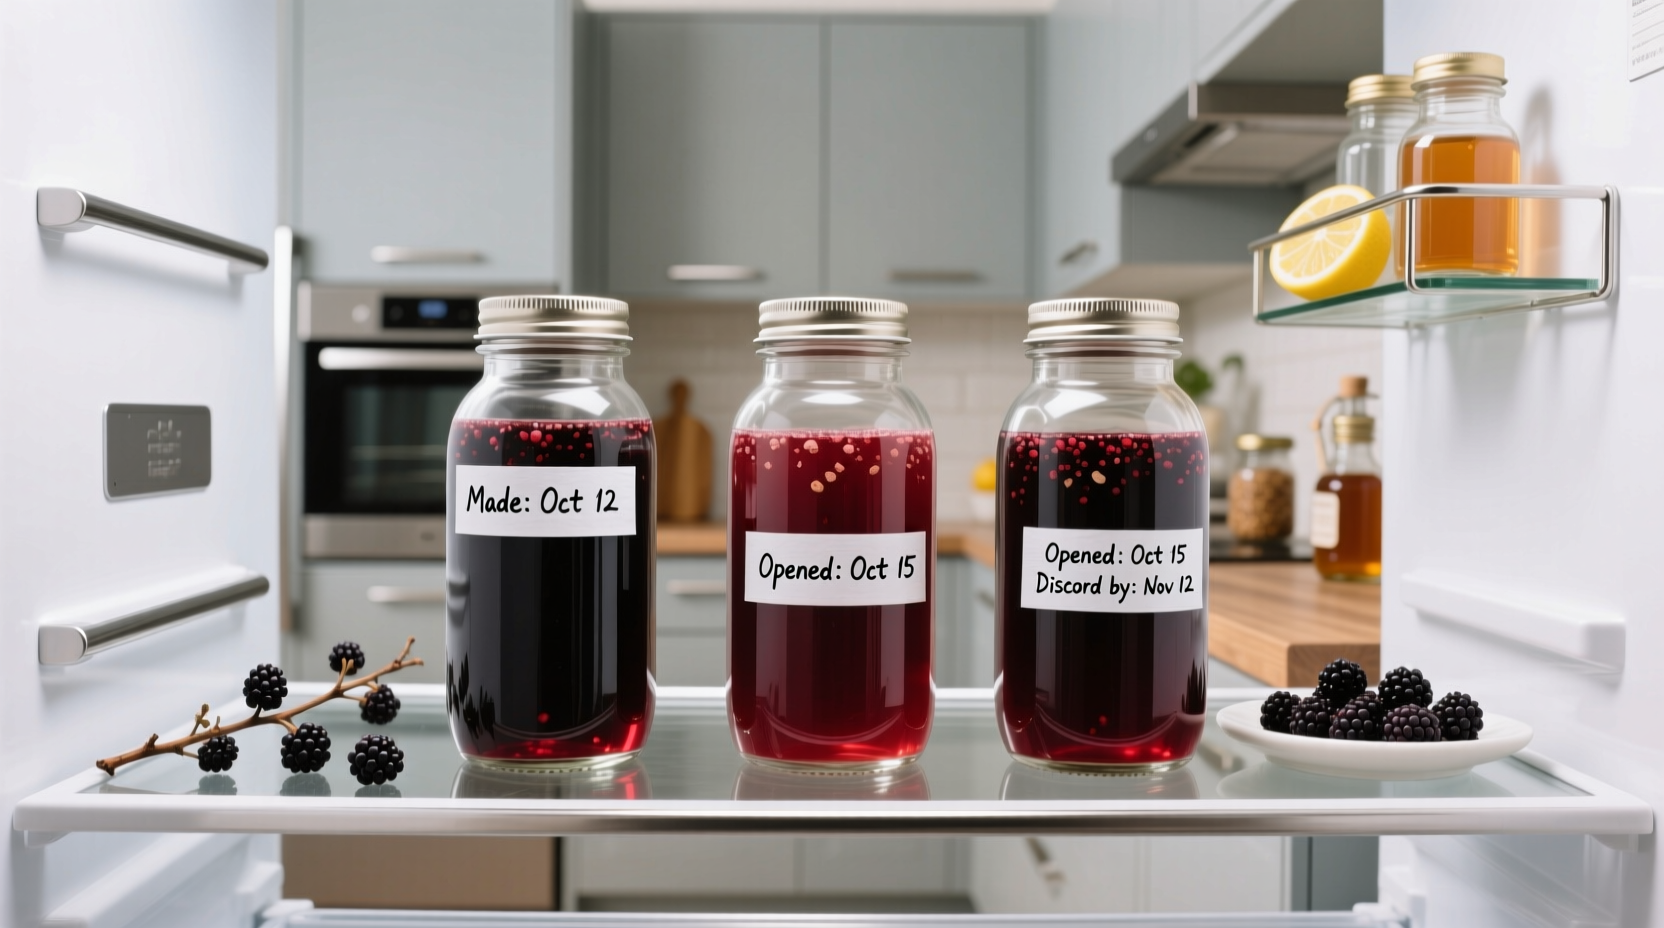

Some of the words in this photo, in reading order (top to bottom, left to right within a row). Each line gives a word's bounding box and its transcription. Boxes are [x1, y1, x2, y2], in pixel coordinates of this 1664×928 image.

[466, 484, 530, 514] Made:
[540, 486, 584, 514] Oct
[596, 488, 619, 513] 12
[758, 552, 842, 591] Opened:
[850, 555, 889, 581] Oct
[897, 554, 917, 579] 15
[1045, 541, 1124, 572] Opened:
[1130, 543, 1164, 566] Oct
[1171, 543, 1188, 564] 15
[1036, 571, 1103, 595] Discord
[1109, 574, 1137, 605] by:
[1143, 574, 1174, 596] Nov
[1179, 574, 1195, 594] 12
